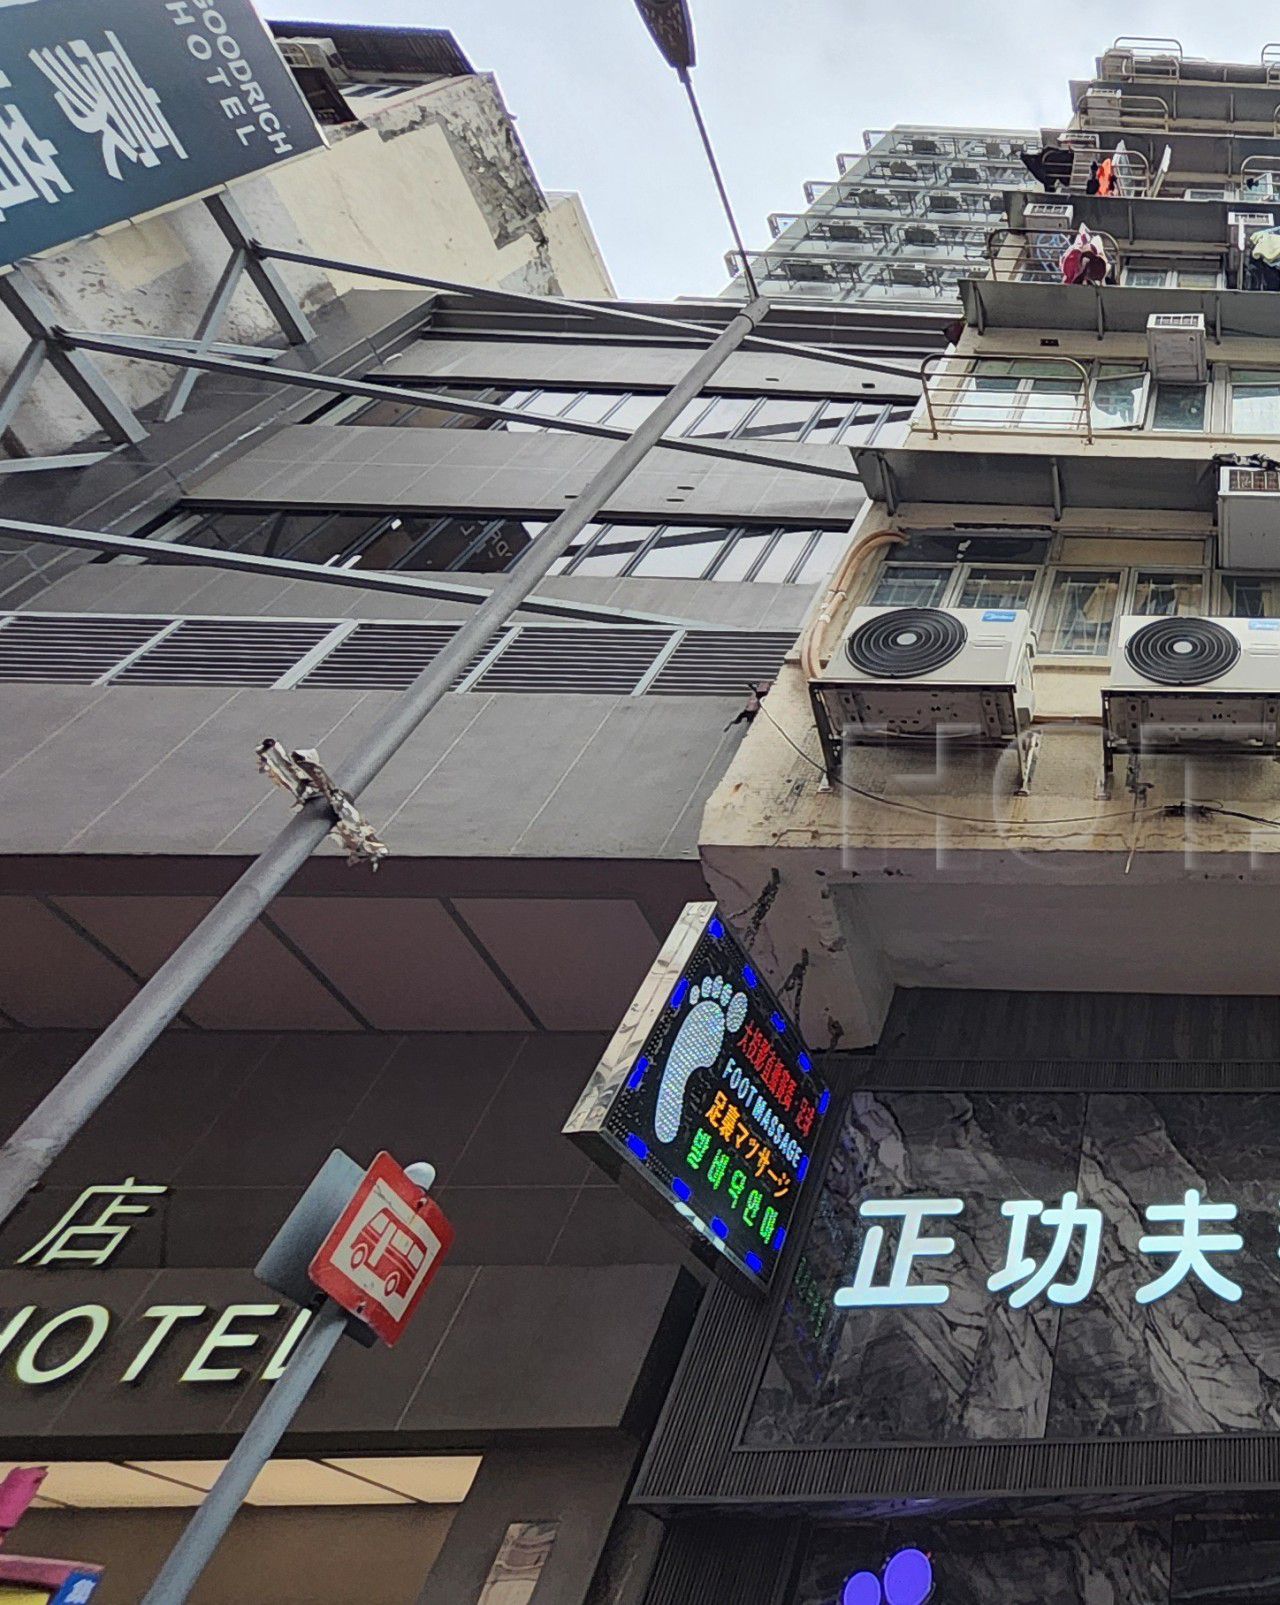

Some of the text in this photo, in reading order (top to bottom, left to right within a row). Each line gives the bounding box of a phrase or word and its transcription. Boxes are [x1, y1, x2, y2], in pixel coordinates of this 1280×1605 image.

[165, 1, 256, 146] HOTEL
[704, 1089, 791, 1199] 足裏マッサージ
[721, 1057, 803, 1169] FOOT MASSAGE
[15, 1176, 168, 1266] 店
